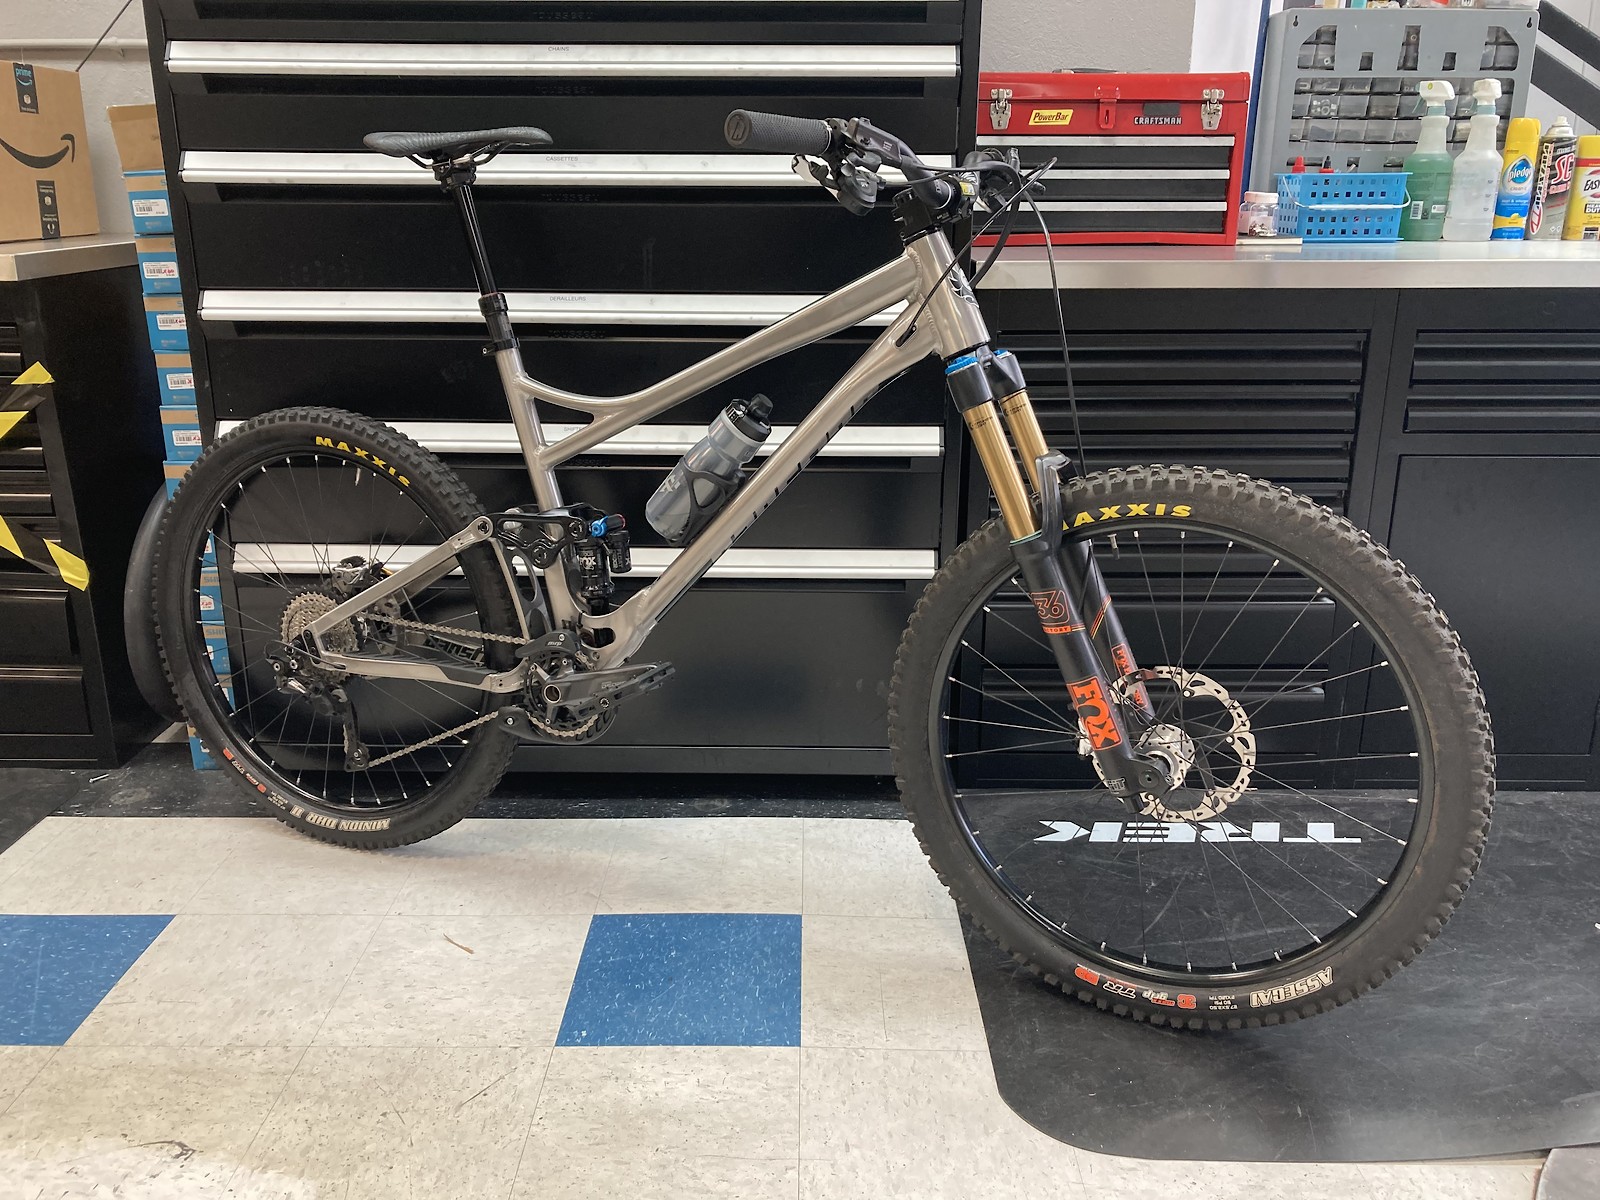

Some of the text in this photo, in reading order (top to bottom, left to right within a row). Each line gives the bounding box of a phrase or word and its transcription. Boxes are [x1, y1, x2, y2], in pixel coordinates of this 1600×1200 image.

[15, 67, 33, 77] prime
[1033, 111, 1069, 123] PowerBar
[1133, 116, 1183, 125] CRAFTSMAN
[315, 435, 411, 487] MAXXIS
[1033, 590, 1067, 620] 36
[1070, 679, 1121, 749] FOX
[305, 811, 339, 830] DHR
[338, 817, 392, 832] MINION
[1033, 820, 1362, 843] TREK
[1102, 980, 1137, 999] TR
[1249, 966, 1335, 1008] ASSEGAI
